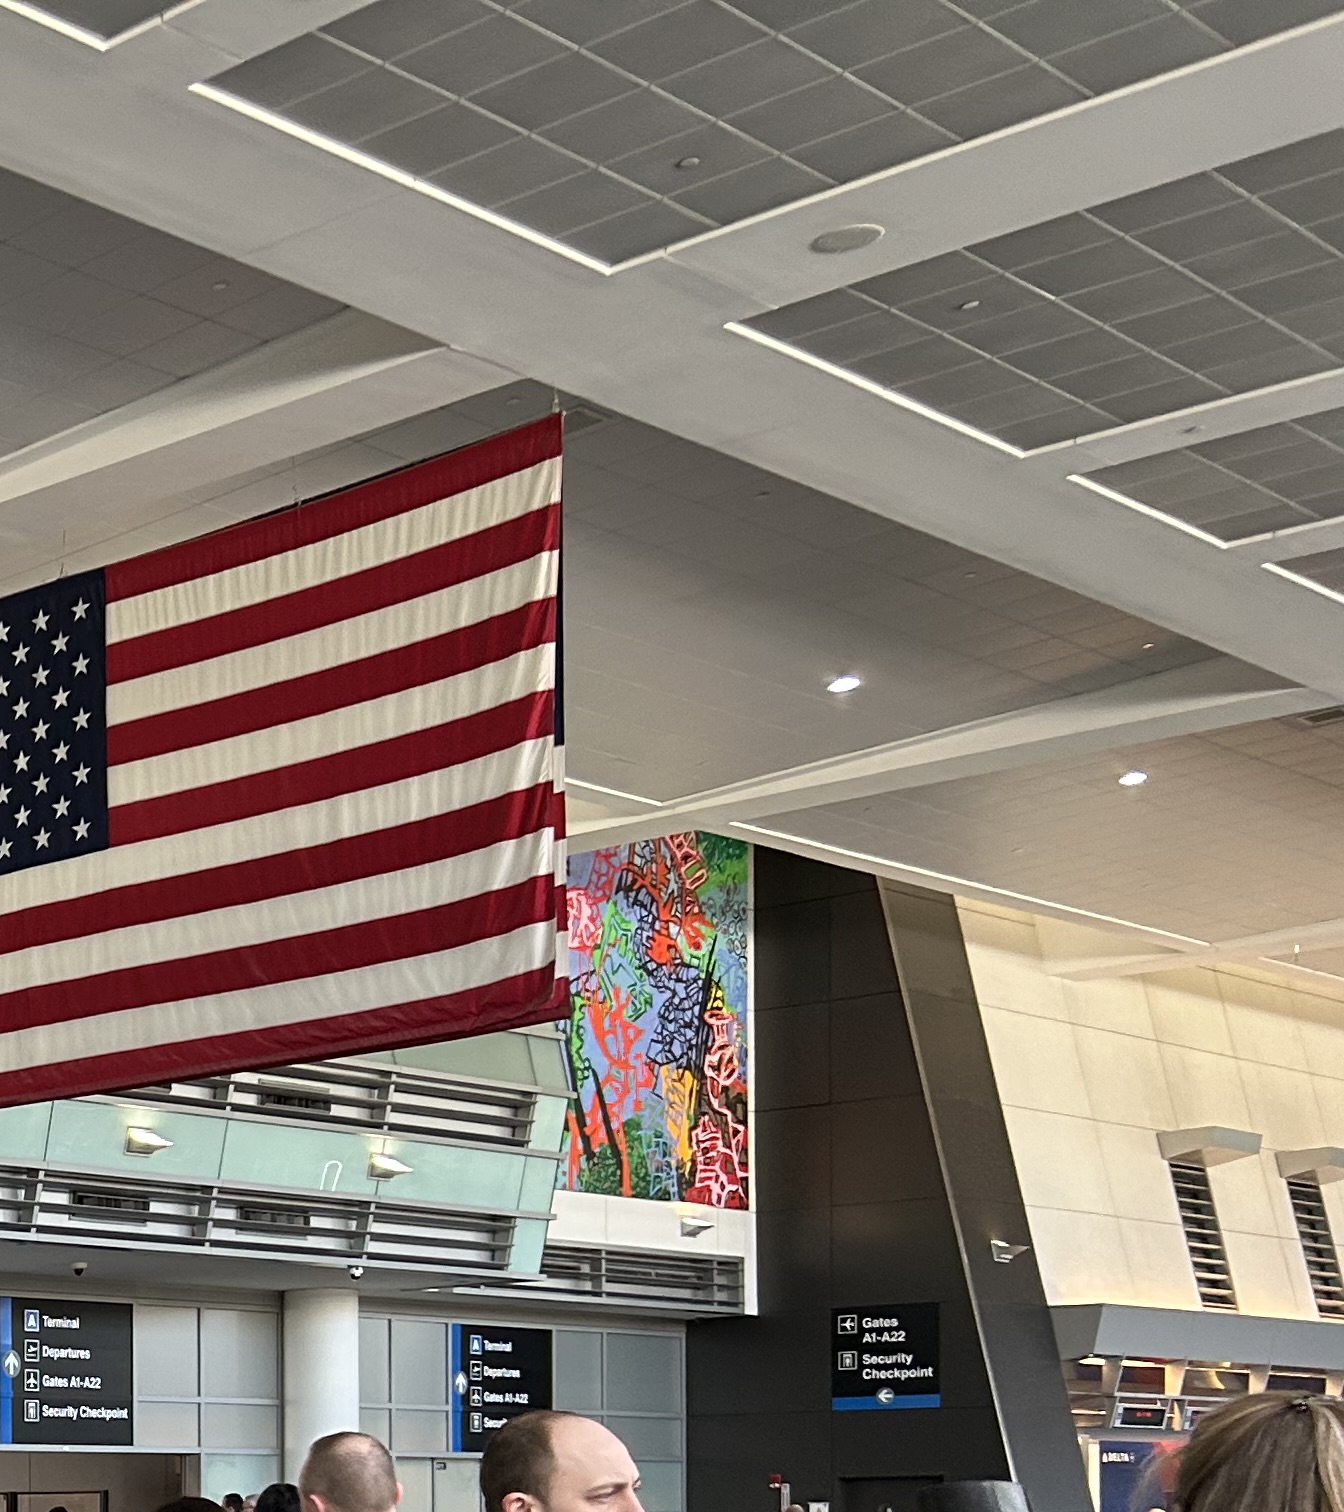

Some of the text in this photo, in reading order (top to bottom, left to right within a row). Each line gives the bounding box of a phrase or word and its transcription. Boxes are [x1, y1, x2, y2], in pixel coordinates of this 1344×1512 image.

[42, 1315, 80, 1329] Terminal
[862, 1317, 899, 1328] Gates
[862, 1331, 906, 1343] A1-A22
[42, 1345, 91, 1360] Departures
[862, 1353, 913, 1365] Security
[862, 1366, 934, 1381] Checkpoint
[42, 1375, 102, 1389] Gates A1-A22
[42, 1405, 129, 1421] Security Checkpoint
